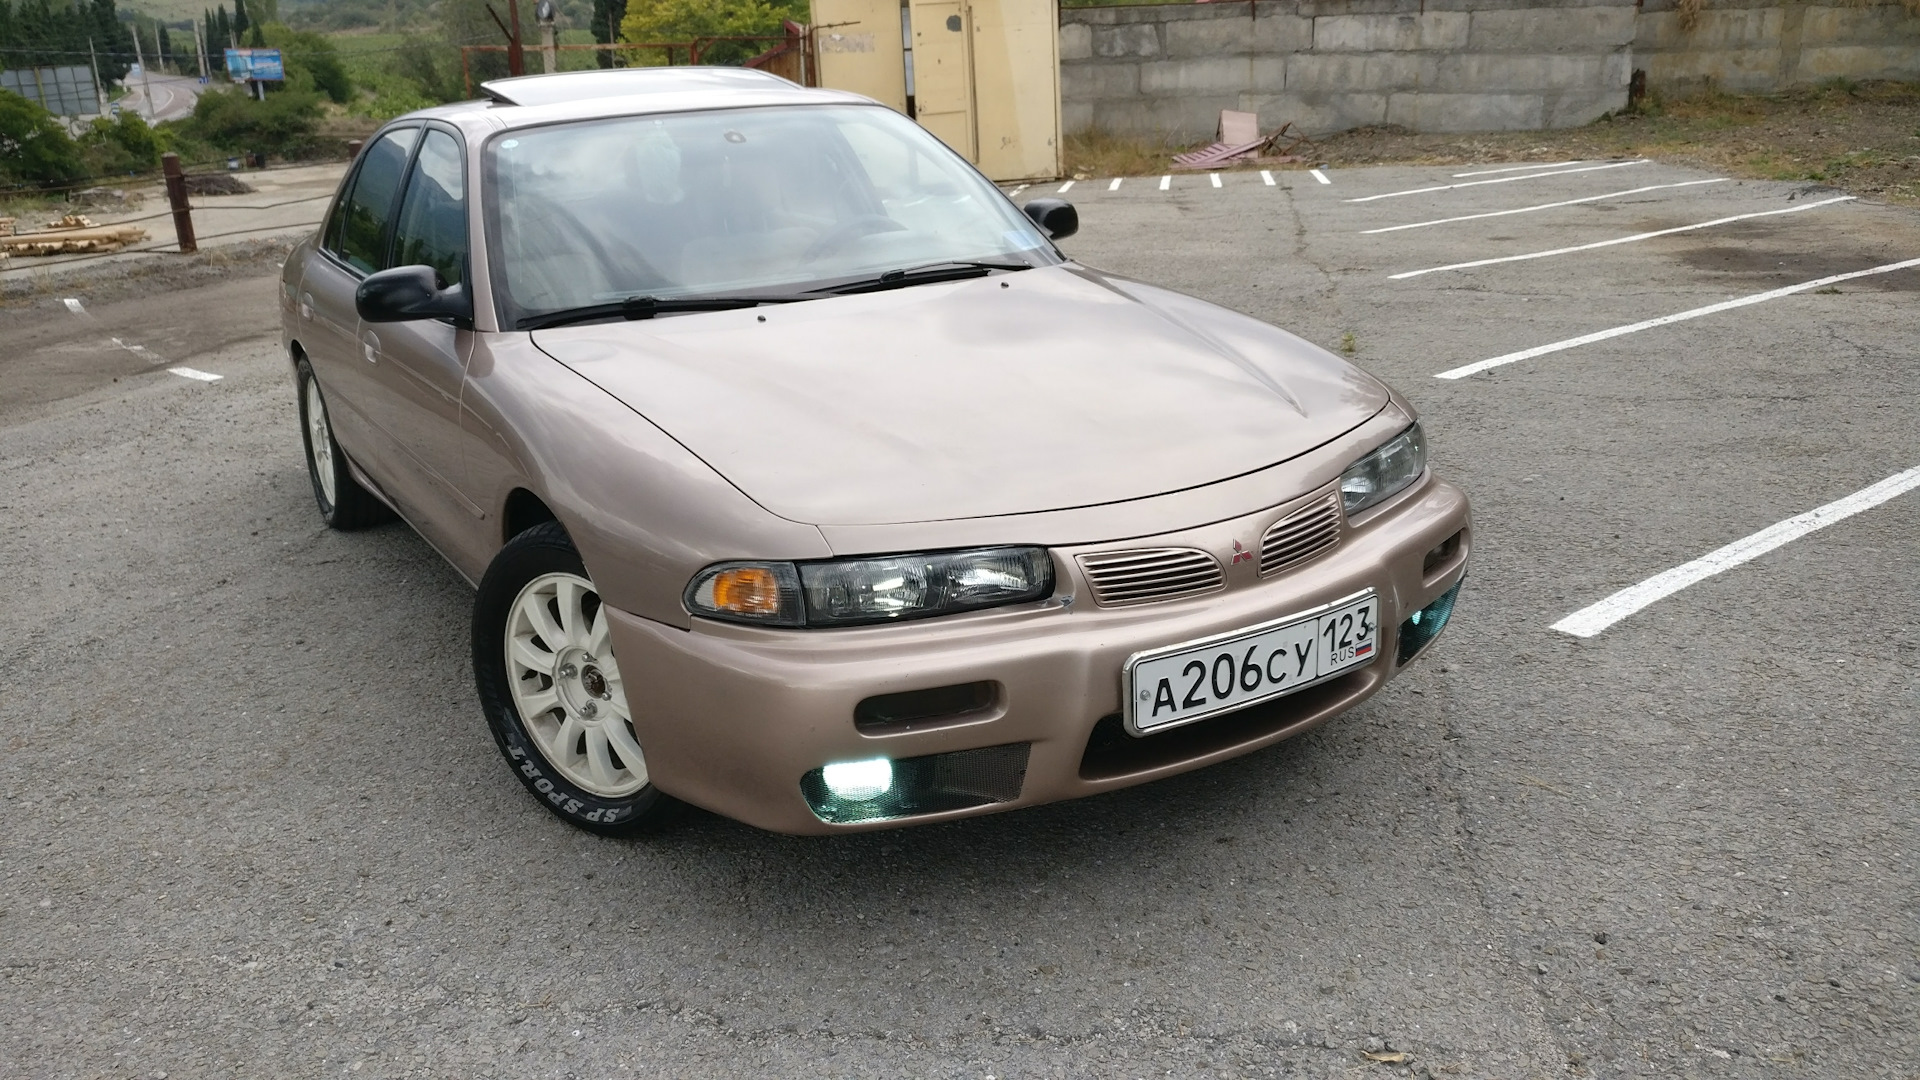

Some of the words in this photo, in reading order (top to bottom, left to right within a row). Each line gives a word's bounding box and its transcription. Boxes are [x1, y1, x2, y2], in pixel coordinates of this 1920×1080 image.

[1323, 606, 1370, 653] 123
[1330, 646, 1355, 666] RUS
[507, 745, 584, 814] SPORT
[585, 808, 620, 822] SP
